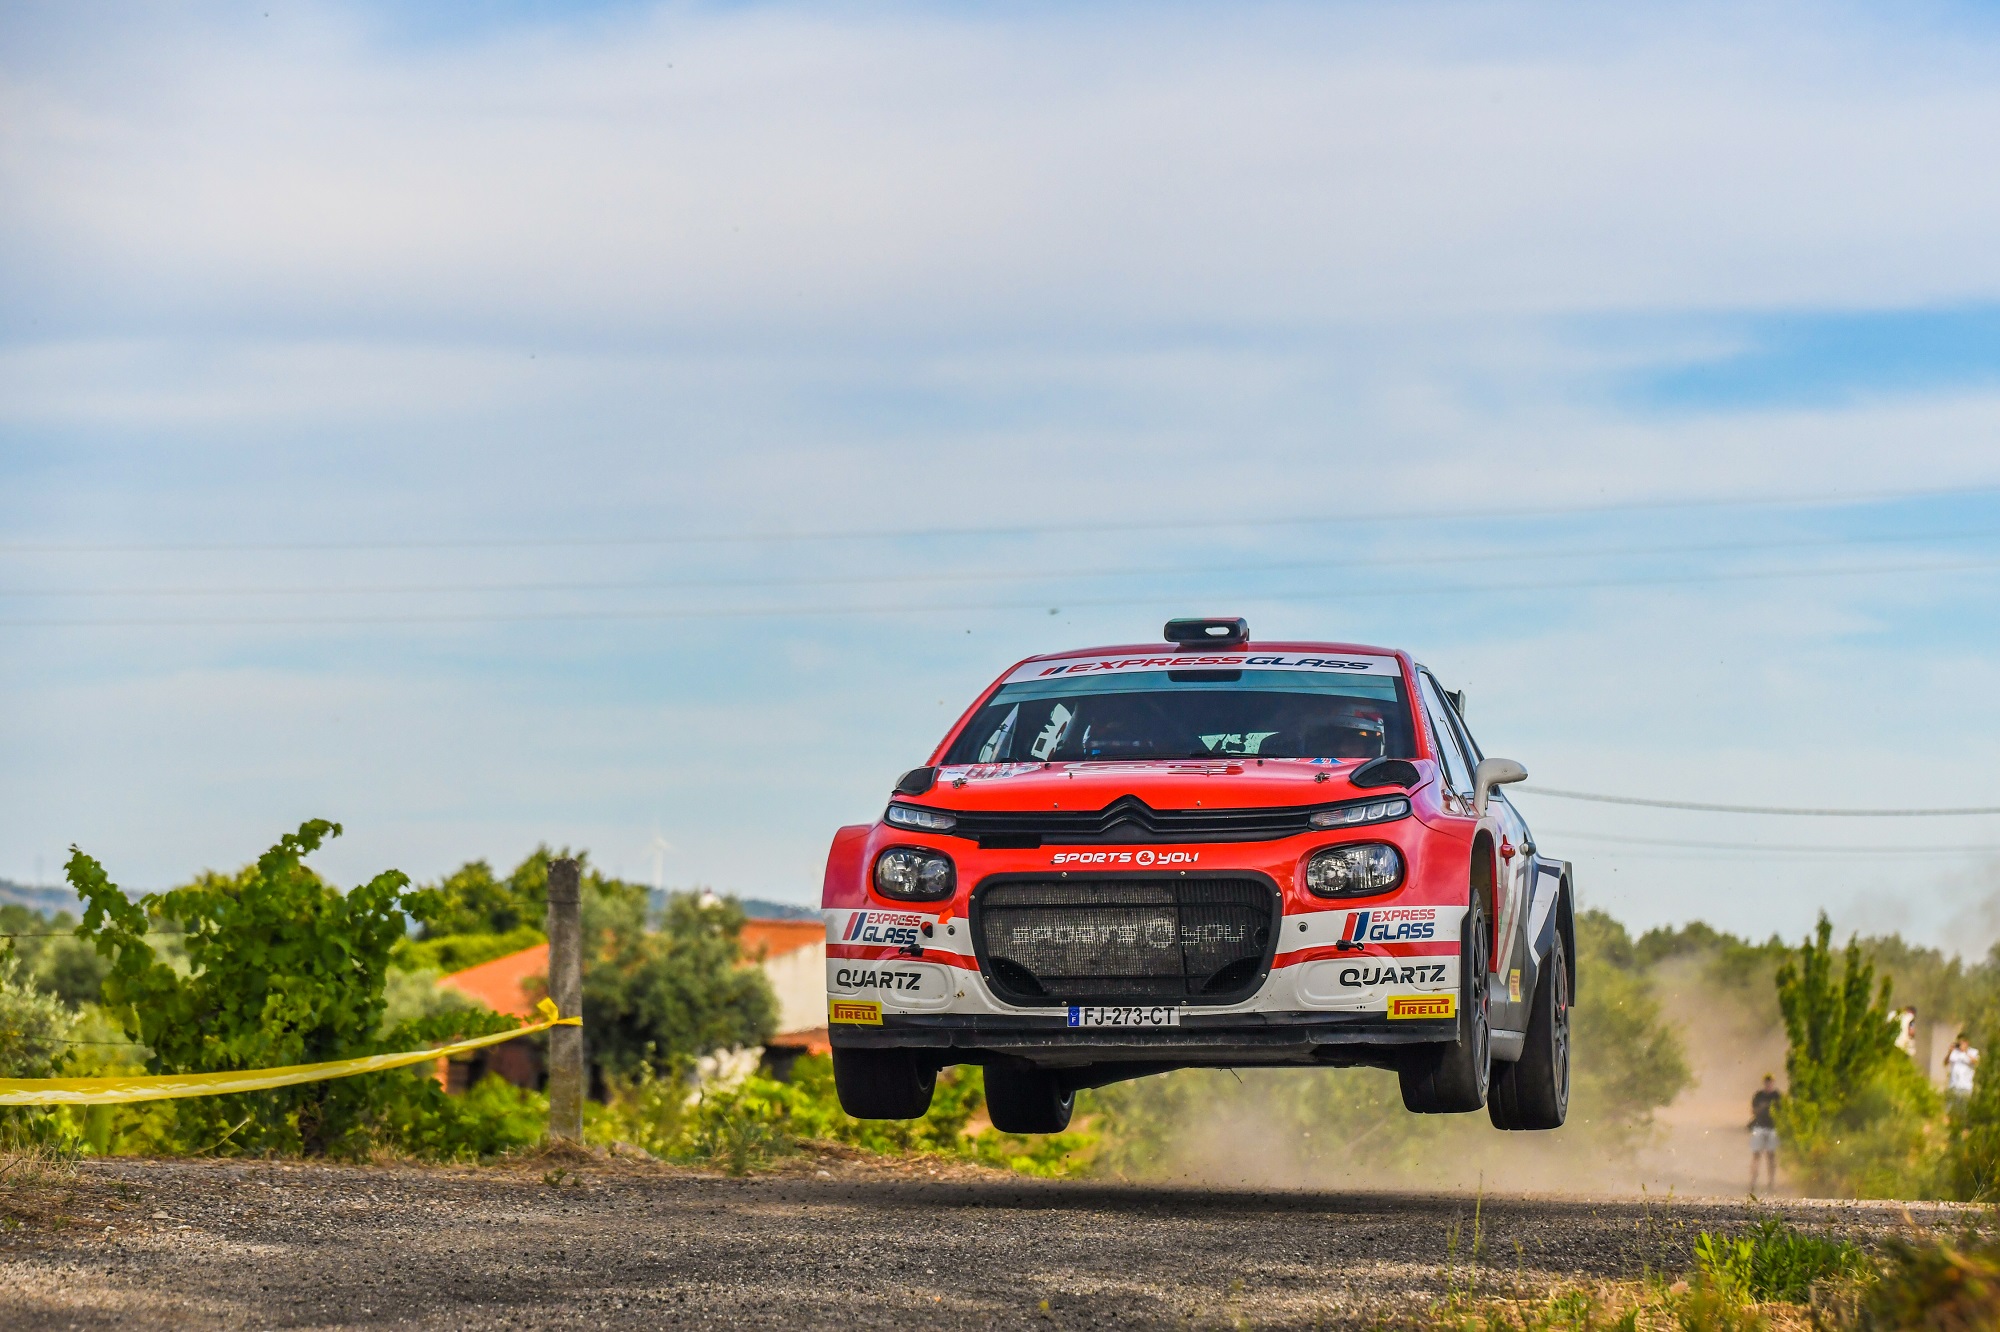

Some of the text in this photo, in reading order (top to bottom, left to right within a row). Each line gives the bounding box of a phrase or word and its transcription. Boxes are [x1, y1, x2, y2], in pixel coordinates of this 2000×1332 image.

[1053, 852, 1132, 864] SPORTS
[866, 912, 922, 927] EXPRESS
[1371, 909, 1436, 922] EXPRESS
[862, 926, 919, 944] GLASS
[1369, 922, 1435, 940] GLASS
[836, 968, 922, 990] QUARTZ
[1339, 964, 1446, 988] QUARTZ
[834, 1003, 877, 1021] PIRELLI
[1394, 998, 1450, 1015] PIRELLI
[1084, 1007, 1175, 1025] FJ-273-CT
